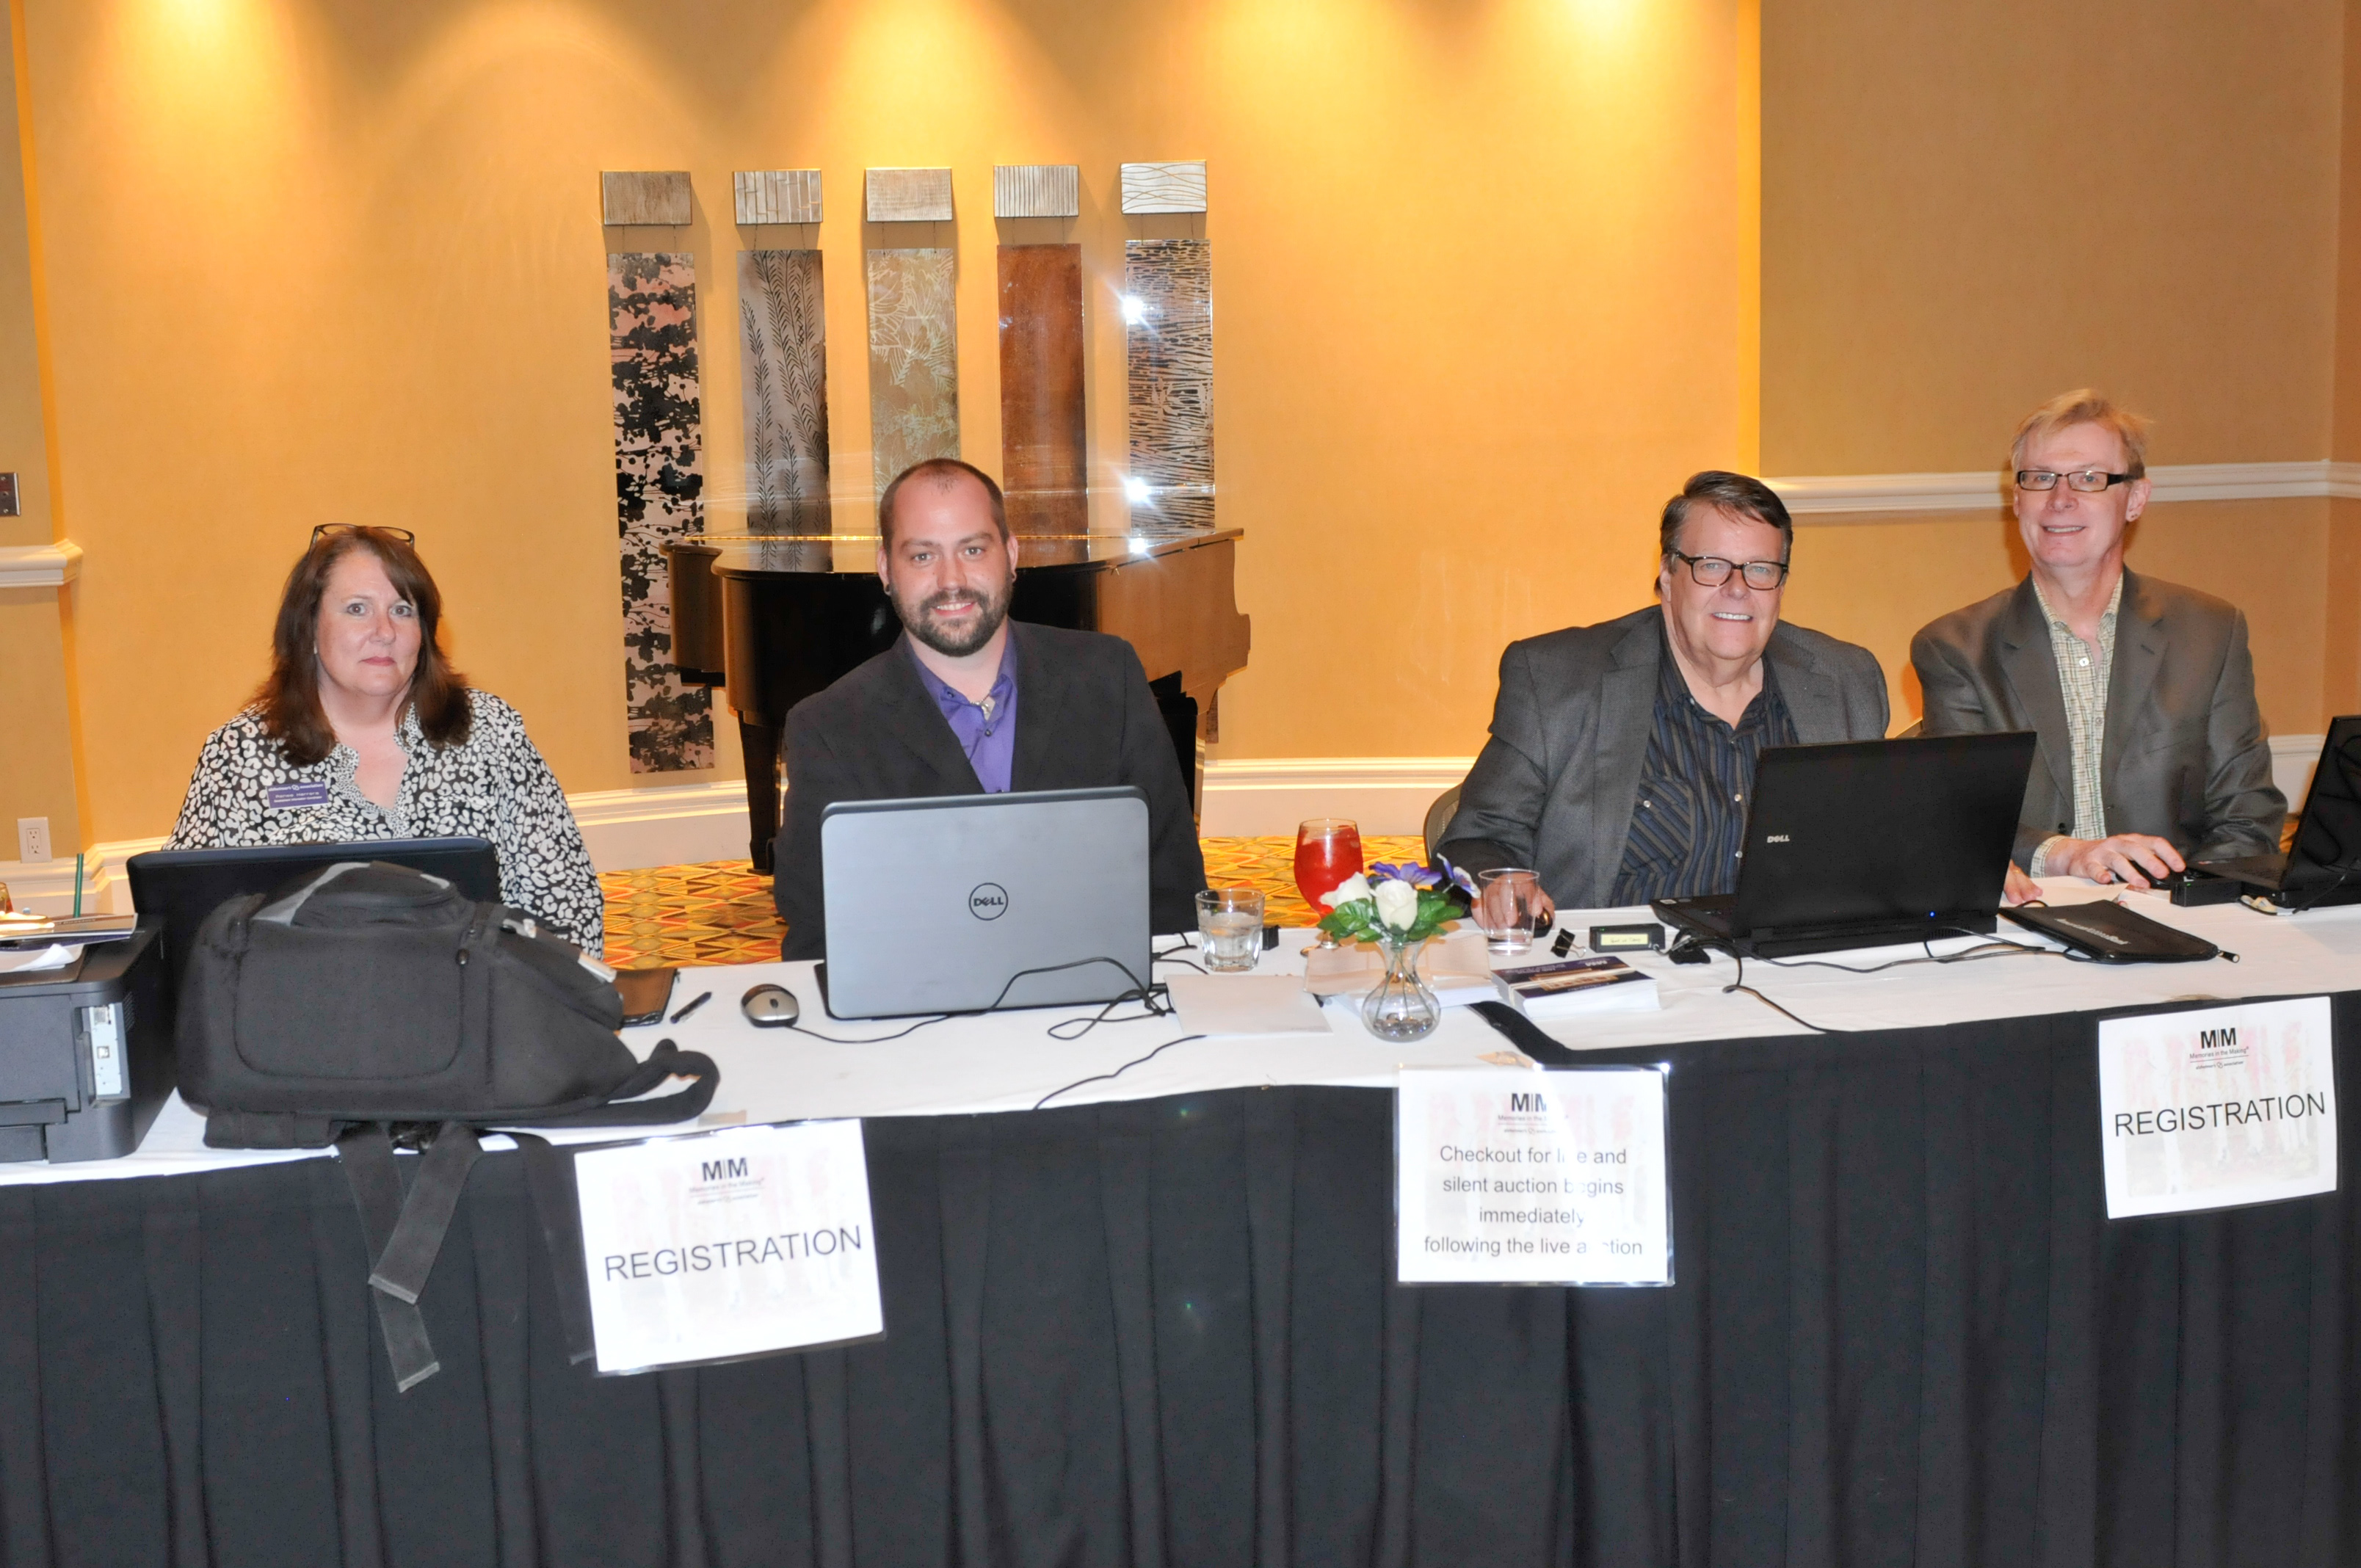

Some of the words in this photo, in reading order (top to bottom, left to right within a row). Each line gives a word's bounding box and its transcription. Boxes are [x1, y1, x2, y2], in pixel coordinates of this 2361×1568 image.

[1766, 835, 1791, 843] DELL
[973, 897, 1004, 907] DELL
[2114, 1091, 2325, 1137] REGISTRATION
[1440, 1144, 1521, 1163] Checkout
[1527, 1146, 1551, 1163] for
[1557, 1147, 1587, 1164] lie
[1593, 1148, 1627, 1164] and
[1443, 1176, 1487, 1192] silent
[1493, 1177, 1557, 1194] auction
[1479, 1208, 1585, 1228] immediately
[604, 1225, 862, 1282] REGISTRATION
[1424, 1236, 1501, 1257] following
[1506, 1238, 1534, 1253] the
[1540, 1238, 1570, 1254] live
[1576, 1238, 1642, 1255] ation
